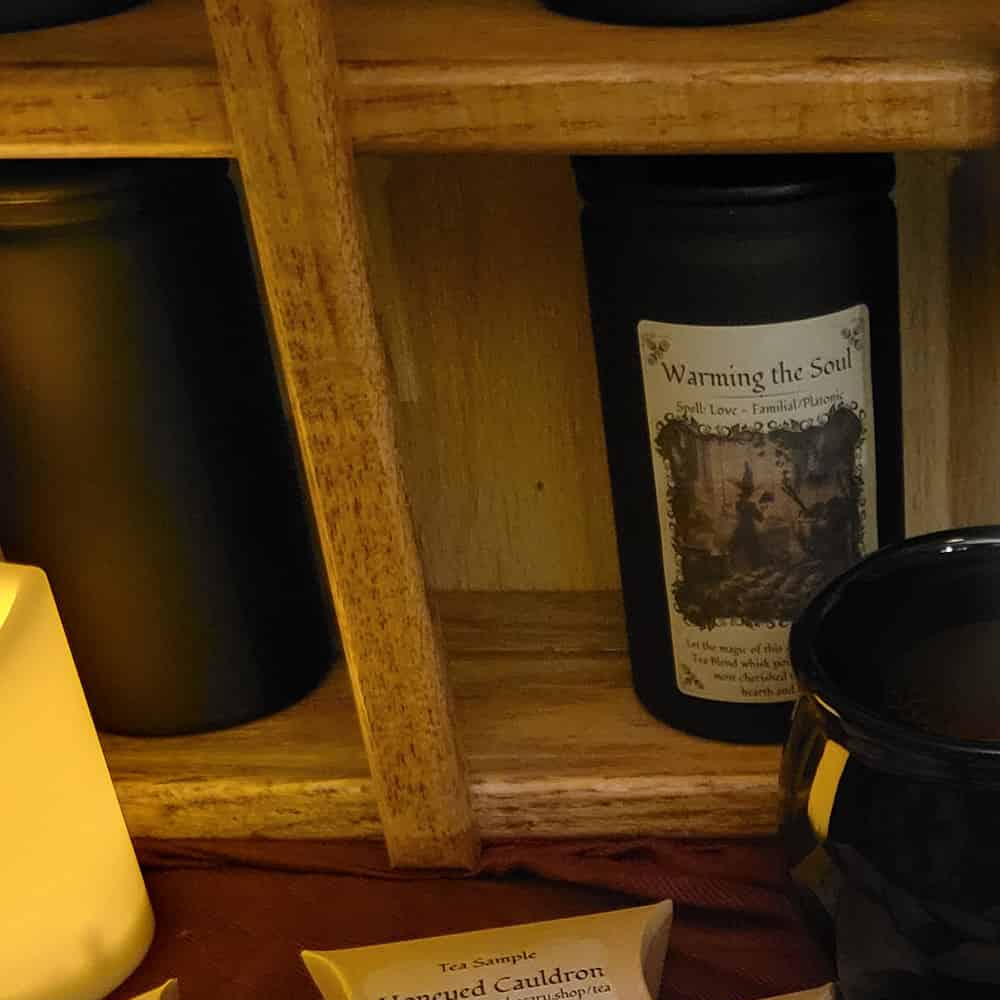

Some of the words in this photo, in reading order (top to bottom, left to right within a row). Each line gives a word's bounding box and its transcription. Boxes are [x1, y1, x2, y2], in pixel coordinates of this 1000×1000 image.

[660, 361, 766, 393] Warming
[772, 361, 803, 386] the
[810, 348, 852, 379] Soul
[710, 403, 737, 416] Love
[437, 961, 467, 973] Tea
[472, 950, 536, 969] Sample
[493, 967, 604, 993] Cauldron
